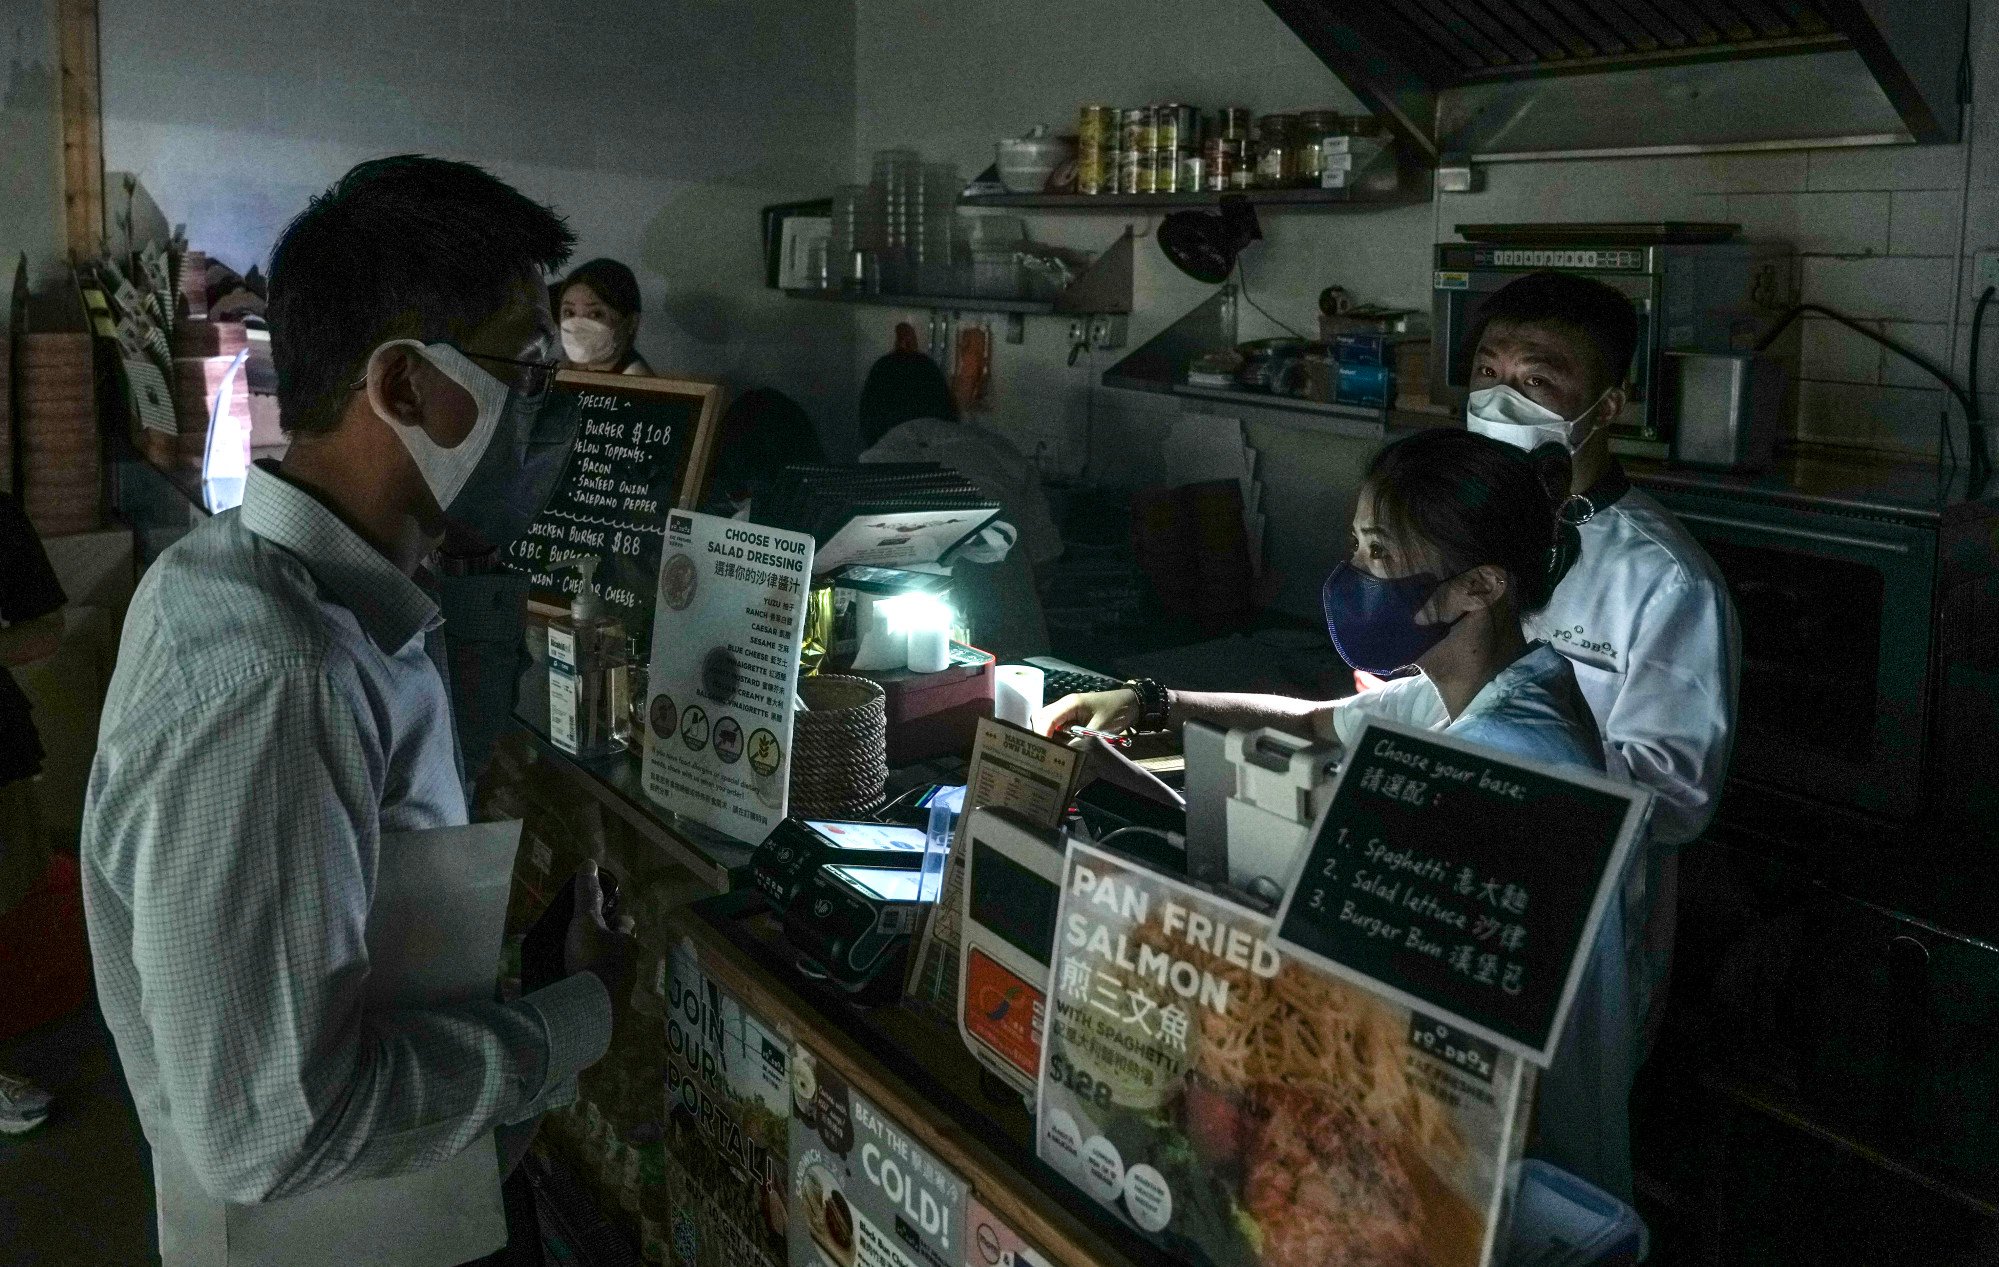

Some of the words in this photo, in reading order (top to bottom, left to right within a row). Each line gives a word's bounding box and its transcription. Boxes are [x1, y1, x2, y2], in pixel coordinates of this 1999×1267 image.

[578, 391, 618, 410] SPECIAL
[586, 419, 624, 439] BURGER
[582, 457, 612, 475] BACON
[605, 443, 645, 462] TOPPINGS
[619, 481, 649, 495] ONION
[623, 498, 657, 513] PEPPER
[569, 526, 604, 548] BURGER
[612, 531, 641, 555] $88
[725, 528, 770, 548] CHOOSE
[774, 538, 805, 555] YOUR
[708, 541, 744, 559] SALAD
[747, 550, 803, 574] DRESSING
[529, 573, 554, 587] NION
[606, 586, 635, 608] CHEESE
[714, 560, 800, 595] 選擇你的沙律醬汁
[746, 607, 768, 620] RANCH
[764, 597, 781, 609] YUZU
[750, 637, 776, 650] SESAME
[752, 623, 777, 636] CAESAR
[727, 644, 743, 655] BLUE
[745, 650, 768, 663] CHEESE
[728, 700, 768, 719] VINAIGRETTE
[738, 690, 764, 703] CREAMY
[1374, 738, 1428, 771] Choose
[1430, 759, 1475, 784] your
[1364, 837, 1452, 883] Spaghetti
[1322, 858, 1339, 882] 2.
[1352, 869, 1400, 905] Salad
[1402, 888, 1467, 931] lettuce
[1073, 864, 1149, 923] PAN
[1162, 903, 1281, 979] FRIED
[1309, 888, 1327, 913] 3.
[1339, 899, 1401, 941] Burger
[1405, 925, 1442, 958] Bun
[1065, 914, 1230, 1015] SALMON
[669, 976, 725, 1053] JOIN
[1060, 956, 1188, 1054] 煎三文魚
[1057, 999, 1093, 1029] WITH
[1096, 1021, 1179, 1074] SPAGHETTI
[668, 1018, 717, 1094] OUR
[667, 1058, 773, 1194] PORTAL!
[856, 1102, 883, 1138] BEAT
[886, 1127, 908, 1161] THE
[862, 1142, 949, 1250] COLD!
